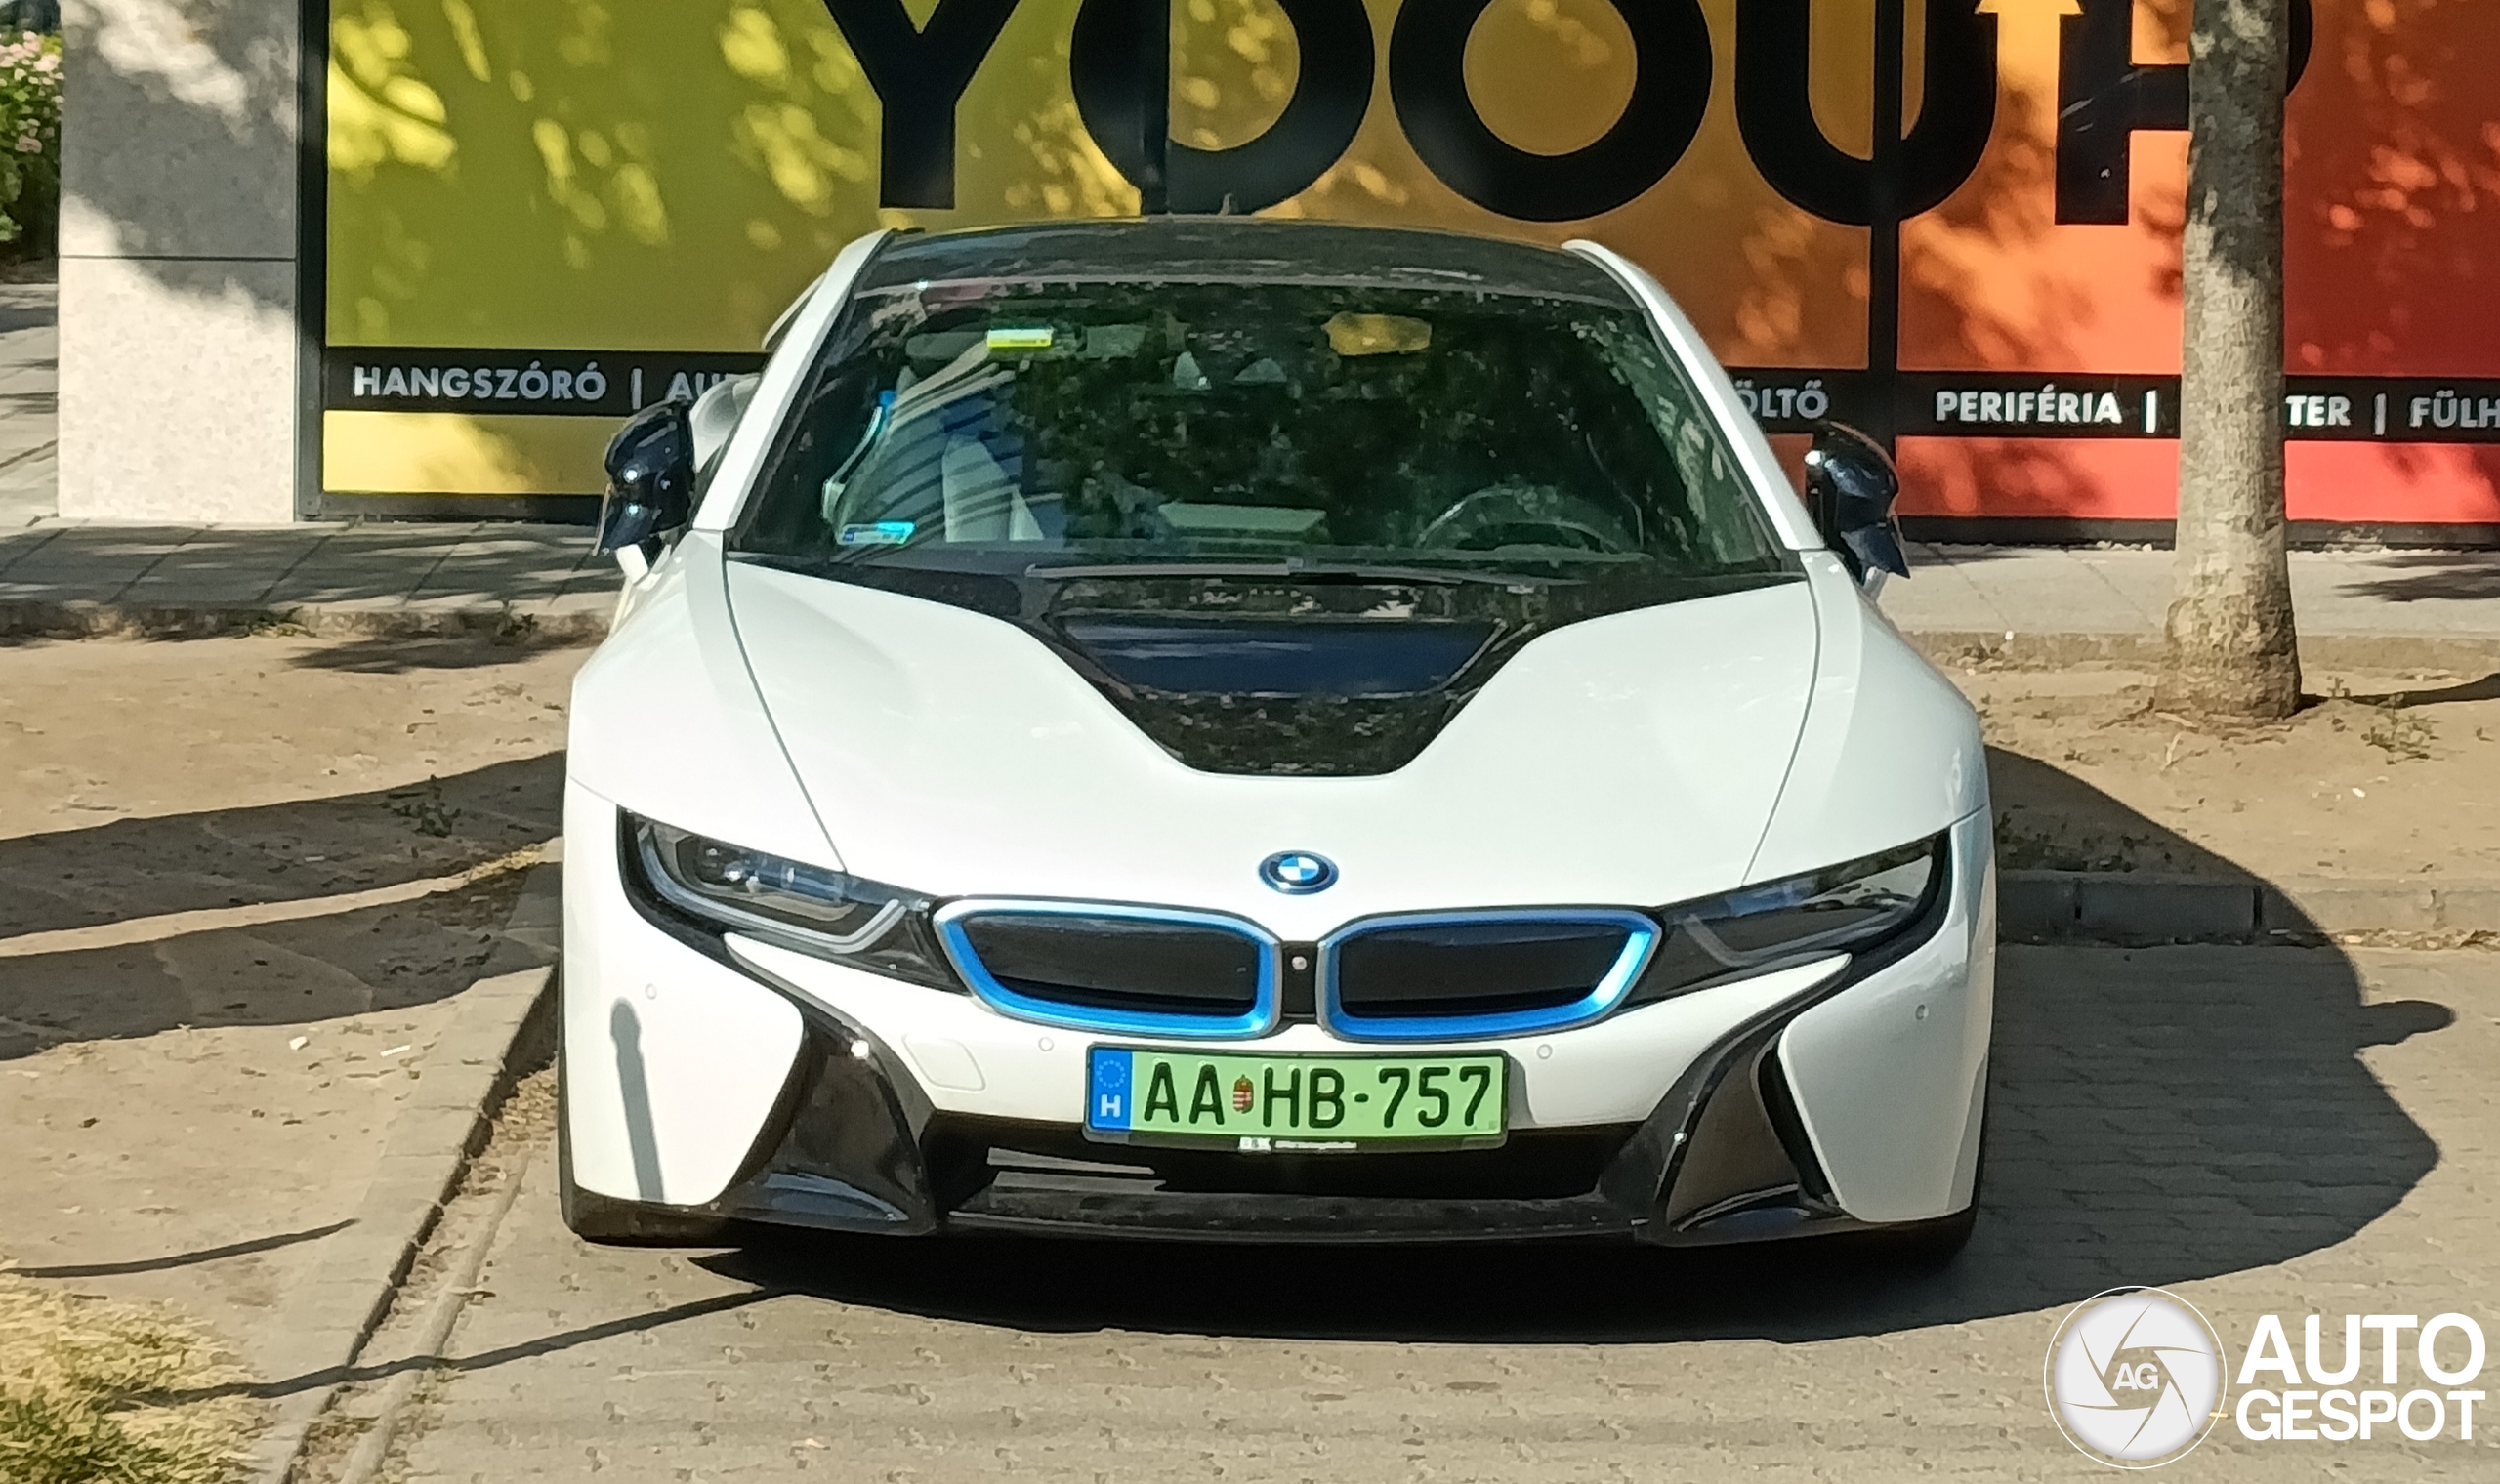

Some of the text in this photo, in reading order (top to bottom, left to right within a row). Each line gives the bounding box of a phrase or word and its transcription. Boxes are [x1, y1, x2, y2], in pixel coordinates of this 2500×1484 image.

[354, 361, 606, 400] HANGSZÓRÓ
[1936, 383, 2122, 425] PERIFÉRIA
[2285, 395, 2351, 427] TER
[1100, 1093, 1121, 1118] H
